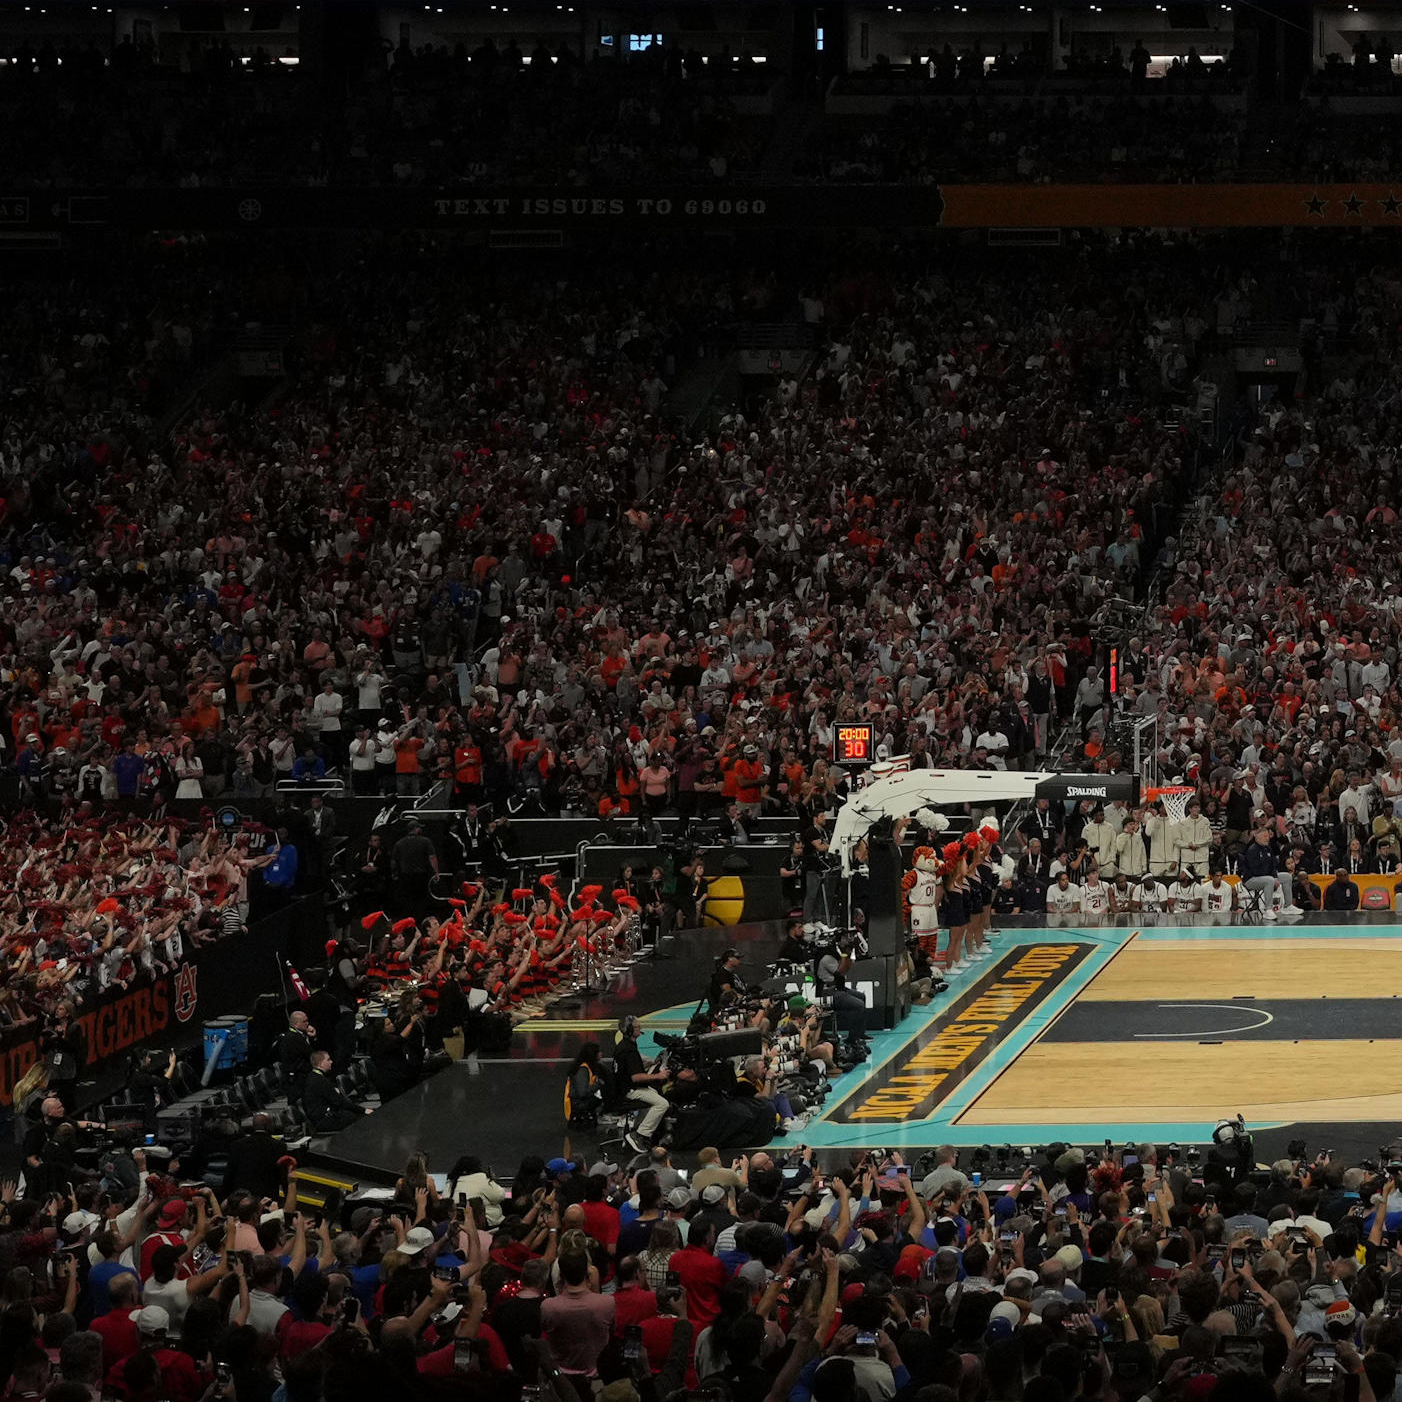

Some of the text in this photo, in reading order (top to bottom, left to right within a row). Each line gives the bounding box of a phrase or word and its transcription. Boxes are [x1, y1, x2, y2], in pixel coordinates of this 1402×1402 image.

[434, 199, 767, 215] TEXT ISSUES TO 69060
[839, 727, 869, 741] 20:00
[845, 741, 864, 757] 30
[1067, 786, 1107, 798] SPALDING
[849, 1072, 950, 1119] NCAA
[956, 980, 1045, 1021] FINAL
[1002, 945, 1080, 979] FOUR
